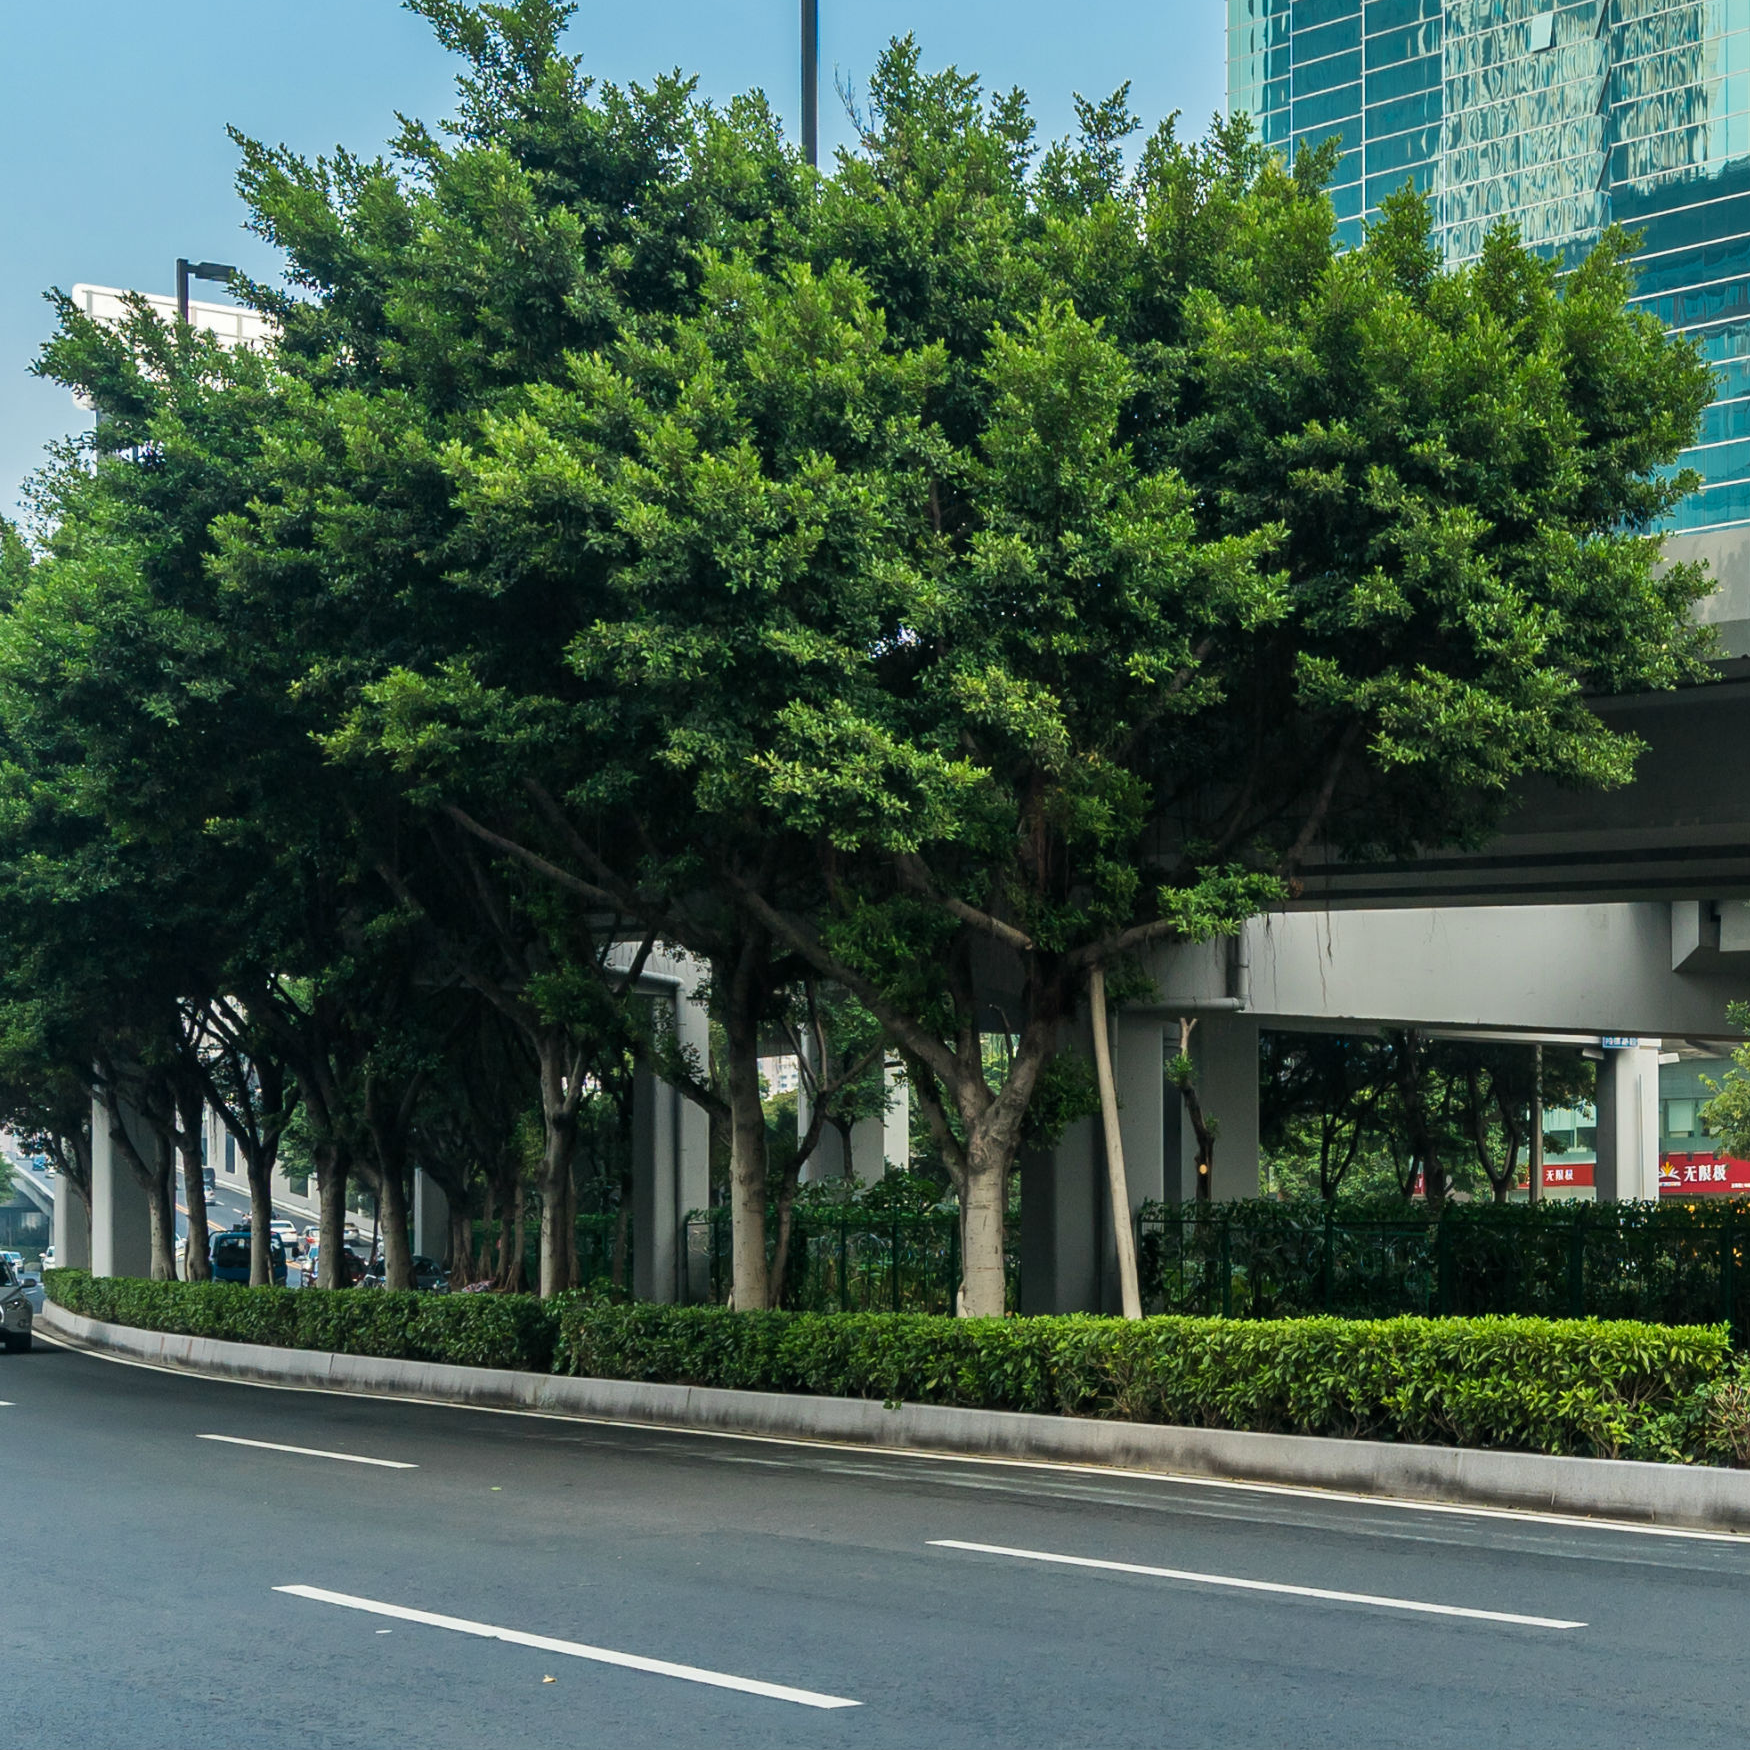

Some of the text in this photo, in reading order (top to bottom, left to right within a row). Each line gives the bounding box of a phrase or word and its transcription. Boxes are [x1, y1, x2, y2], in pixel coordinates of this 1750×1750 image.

[1545, 1169, 1573, 1182] 无限极
[1683, 1164, 1727, 1182] 无限极
